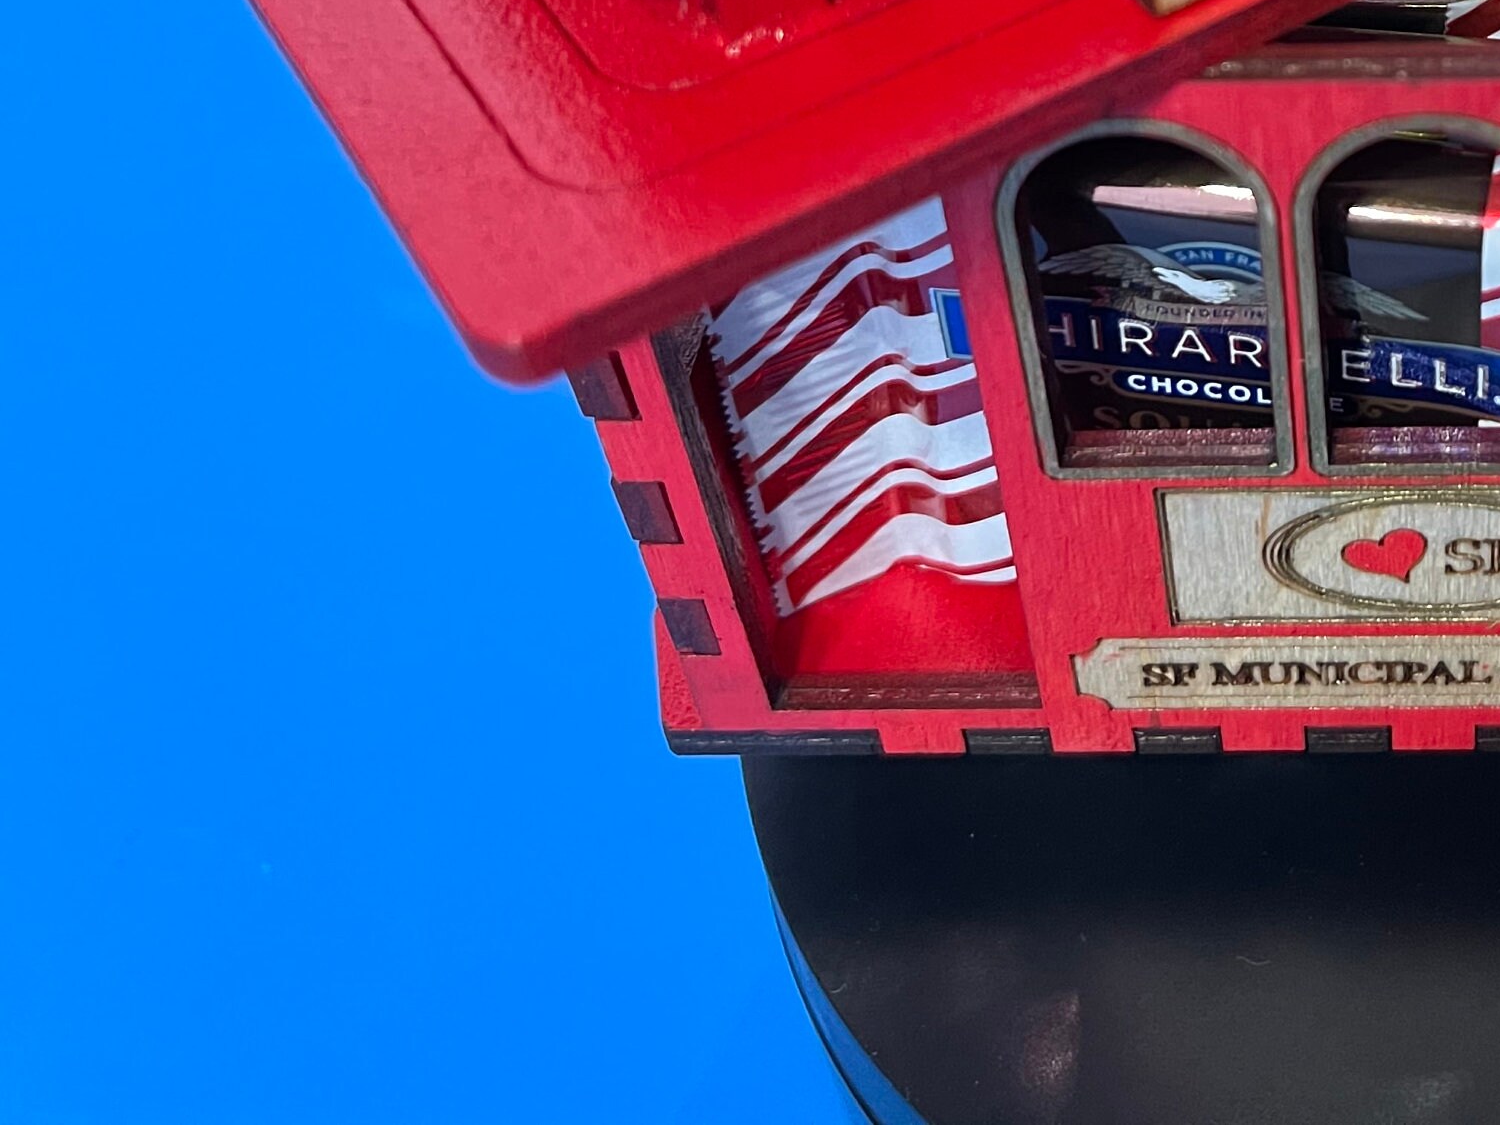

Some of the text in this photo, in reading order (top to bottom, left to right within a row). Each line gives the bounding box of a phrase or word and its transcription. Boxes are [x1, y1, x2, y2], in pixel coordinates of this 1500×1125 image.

[1173, 248, 1215, 264] SAN
[1146, 303, 1238, 318] FOUNDED
[1140, 662, 1199, 688] SF
[1210, 661, 1492, 687] MUNICIPAL
